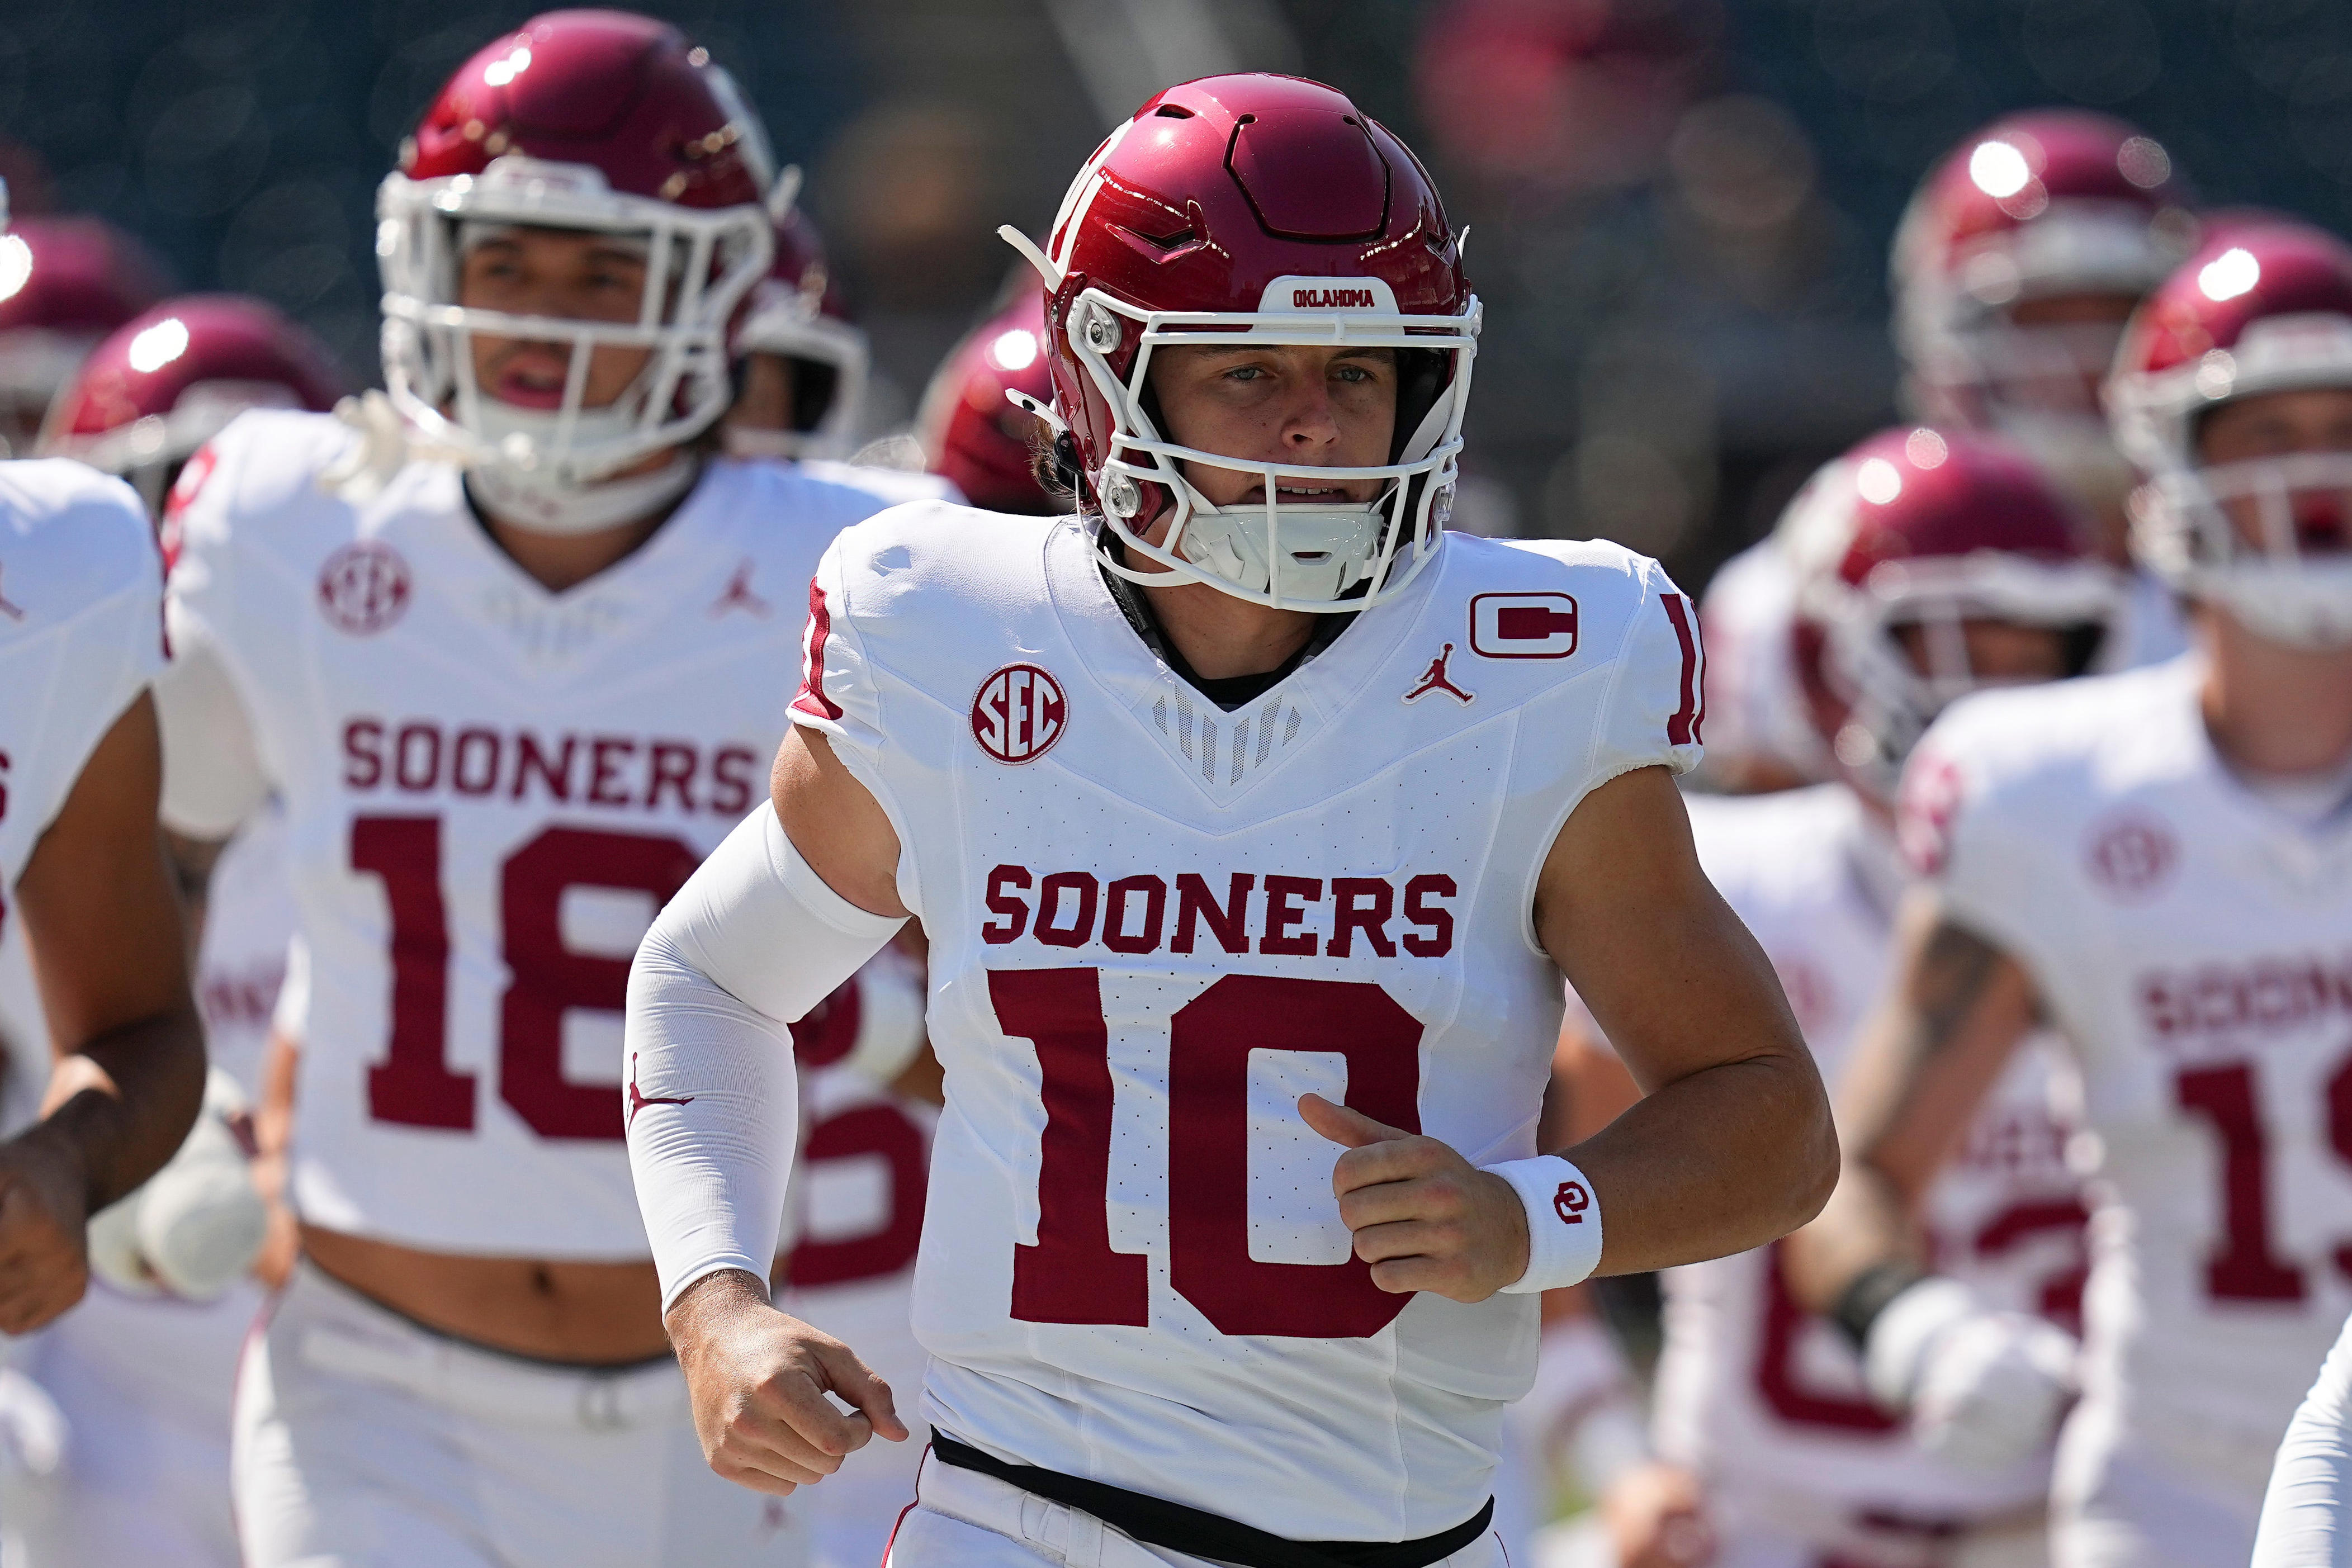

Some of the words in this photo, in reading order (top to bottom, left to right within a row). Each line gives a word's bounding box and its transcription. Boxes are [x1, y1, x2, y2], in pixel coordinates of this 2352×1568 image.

[1293, 289, 1375, 307] OKLAHOMA
[1470, 593, 1578, 659] C
[1659, 593, 1707, 746] 1
[978, 670, 1059, 757] SEC
[344, 718, 756, 815] SOONERS
[982, 864, 1457, 958] SOONERS
[987, 966, 1425, 1338] 10
